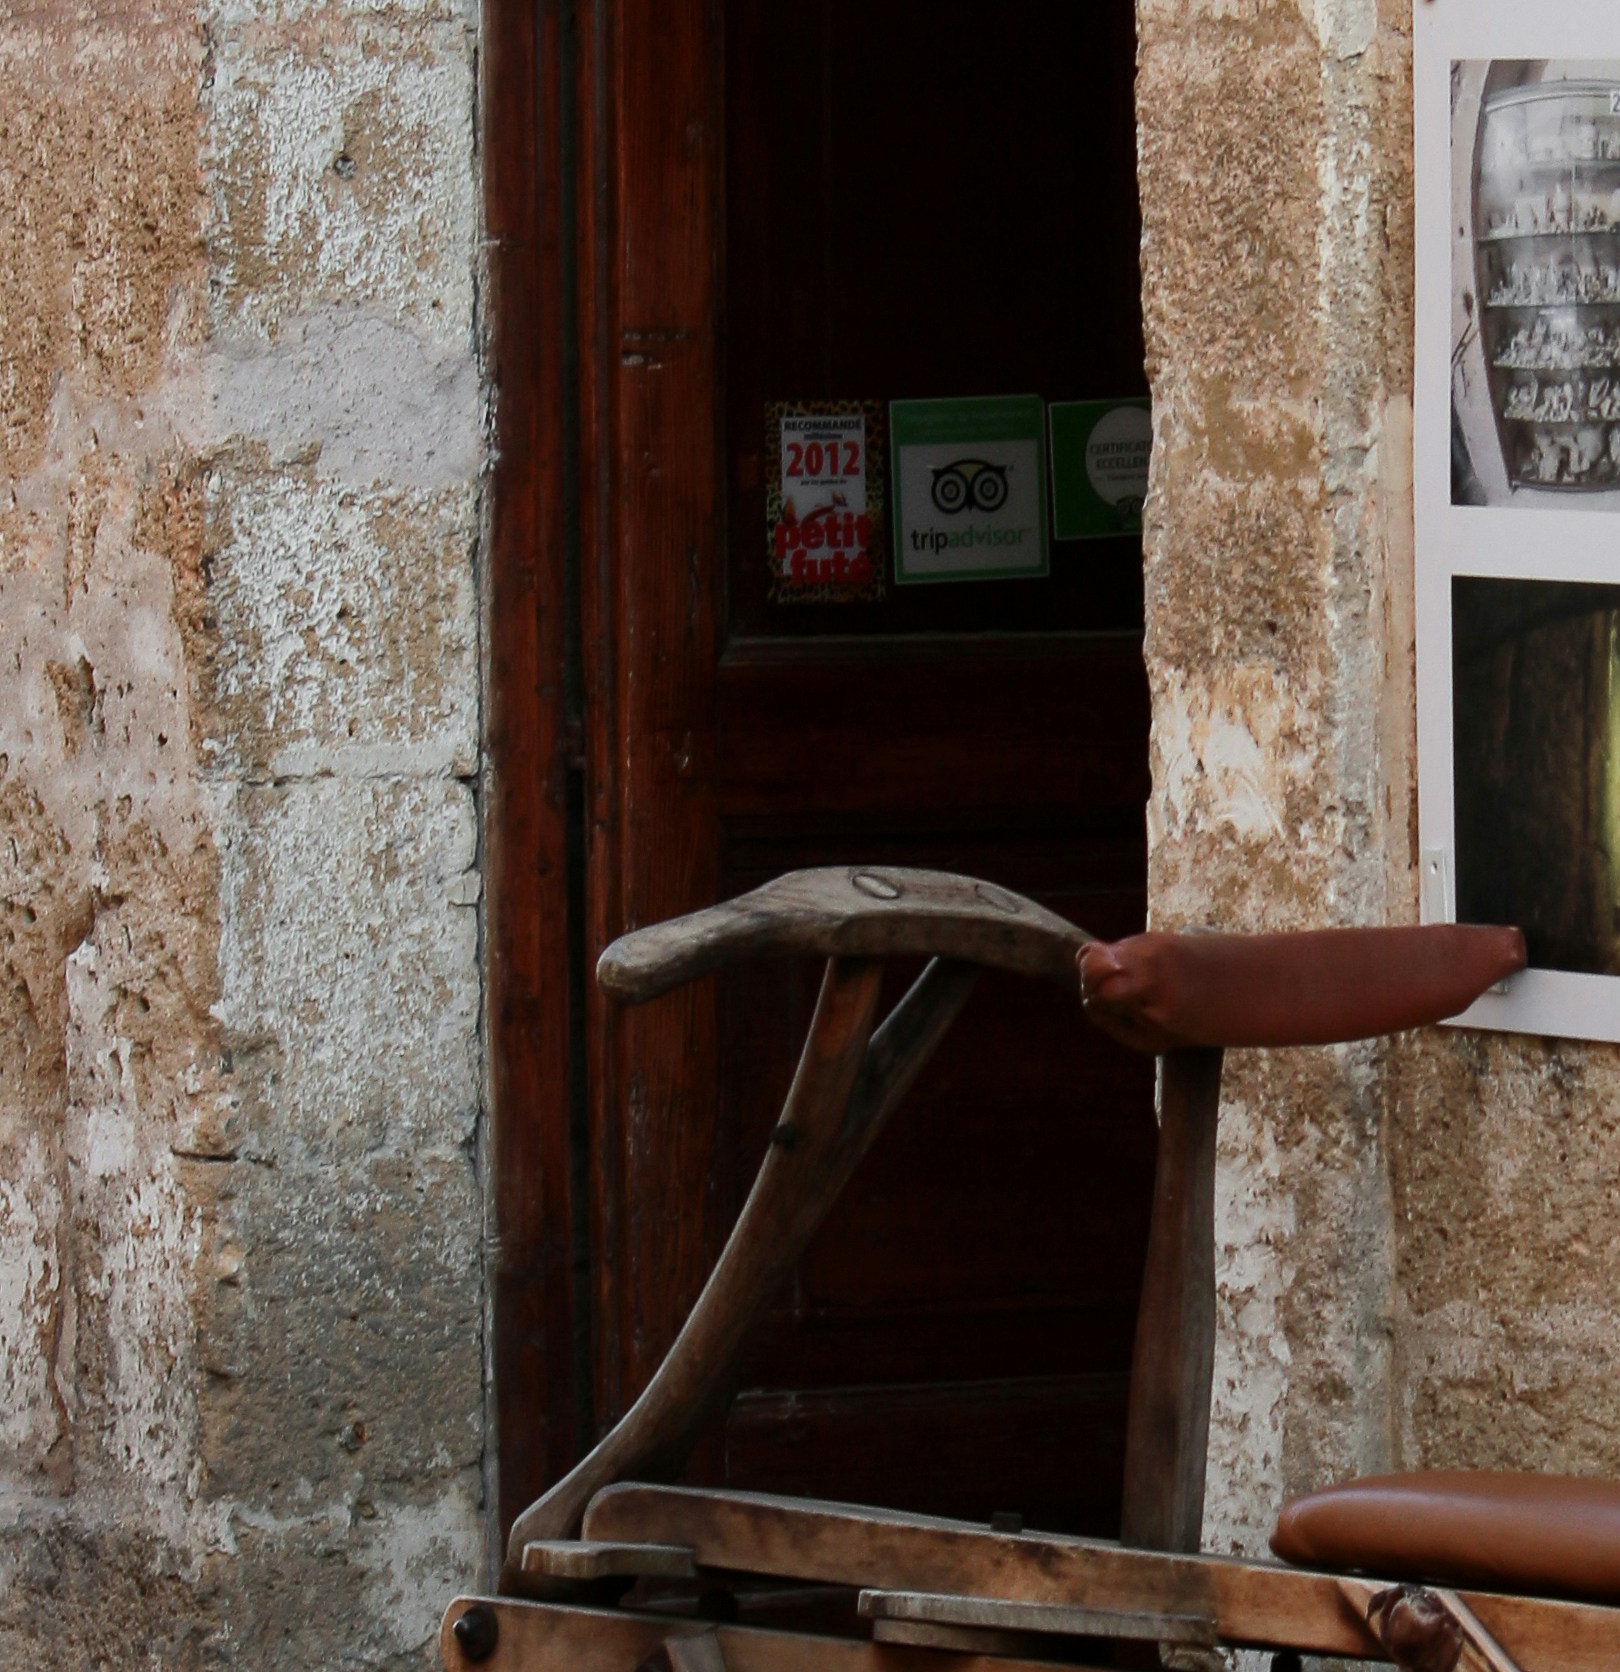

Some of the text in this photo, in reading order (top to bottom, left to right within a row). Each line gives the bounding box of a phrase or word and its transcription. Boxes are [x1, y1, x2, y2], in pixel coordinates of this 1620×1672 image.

[786, 441, 860, 476] 2012
[774, 512, 871, 559] petit
[912, 523, 1023, 556] tripadvisor
